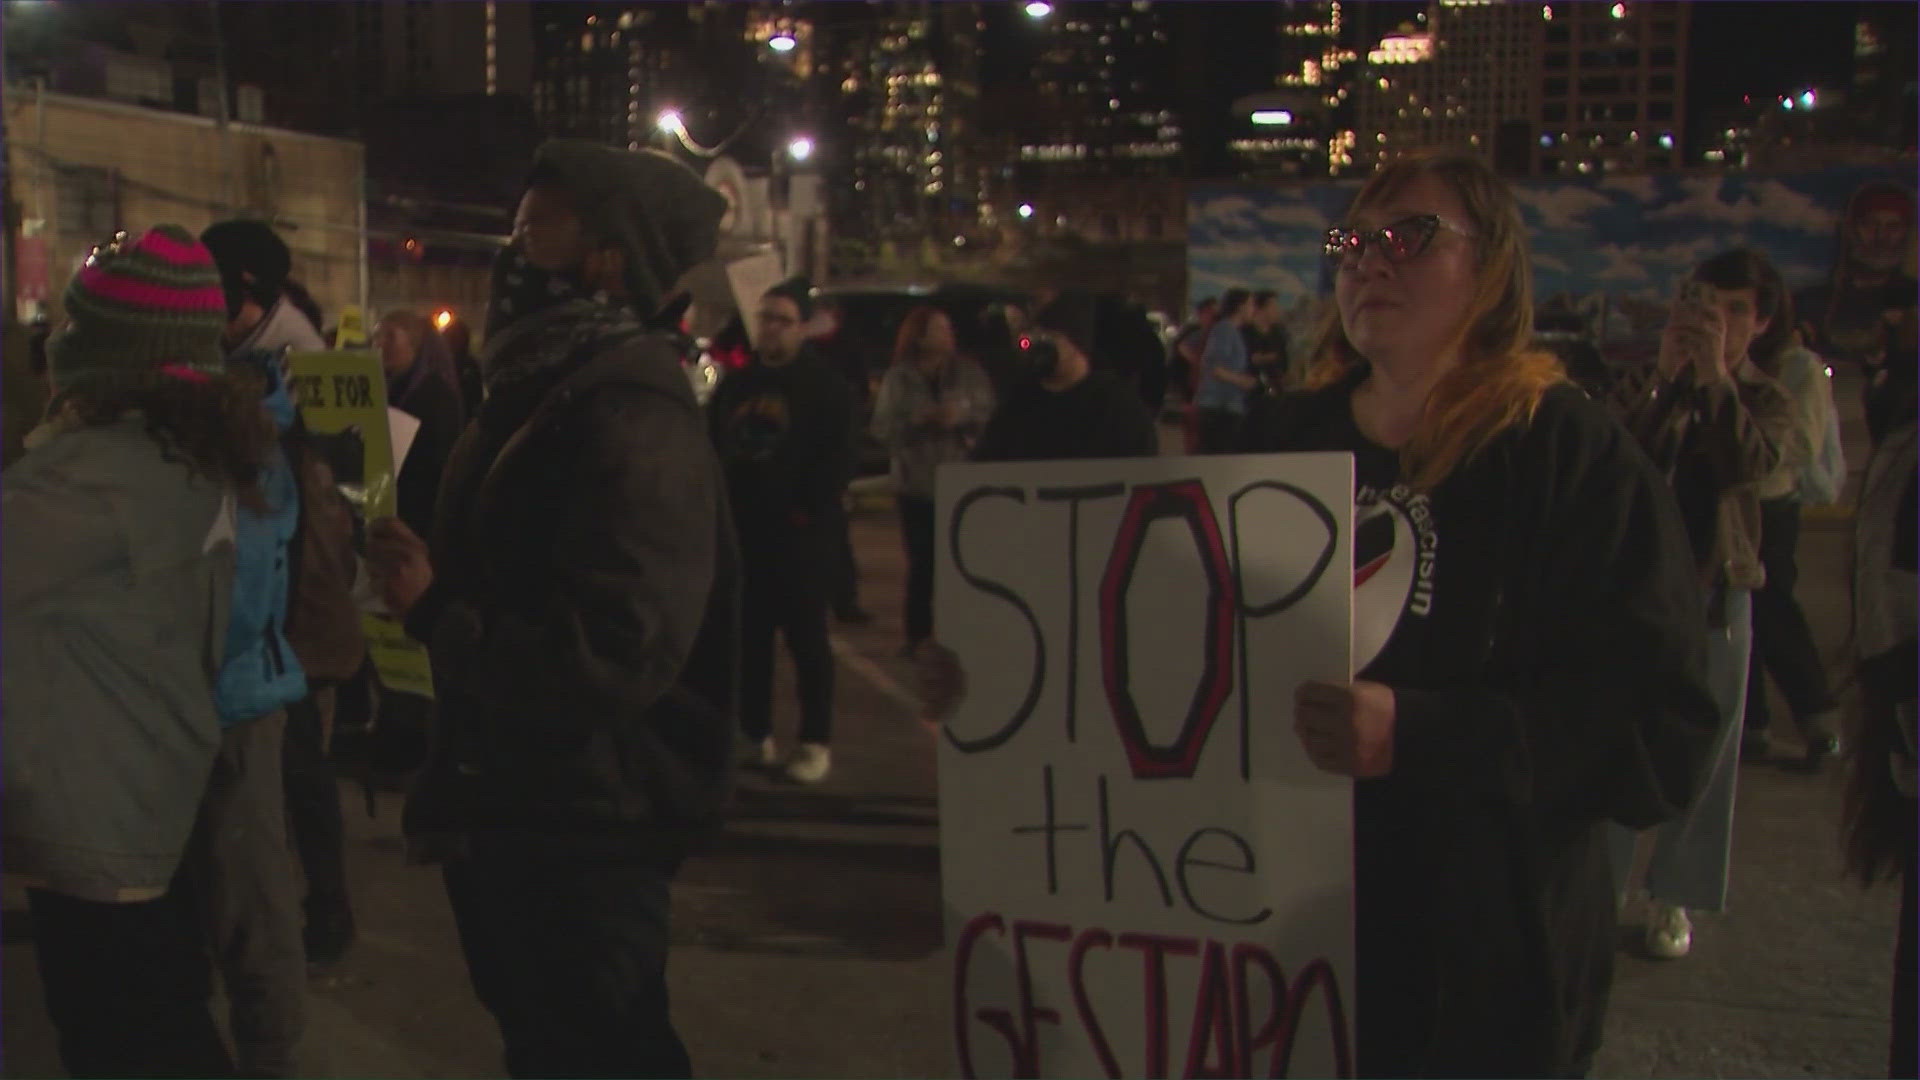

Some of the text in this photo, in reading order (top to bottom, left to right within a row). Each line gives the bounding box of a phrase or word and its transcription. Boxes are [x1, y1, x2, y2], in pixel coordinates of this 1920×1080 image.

[332, 375, 374, 408] FOR
[943, 478, 1338, 782] STOP
[1406, 493, 1439, 617] fascism
[1012, 764, 1273, 925] the
[954, 912, 1353, 1080] GESTAPO
